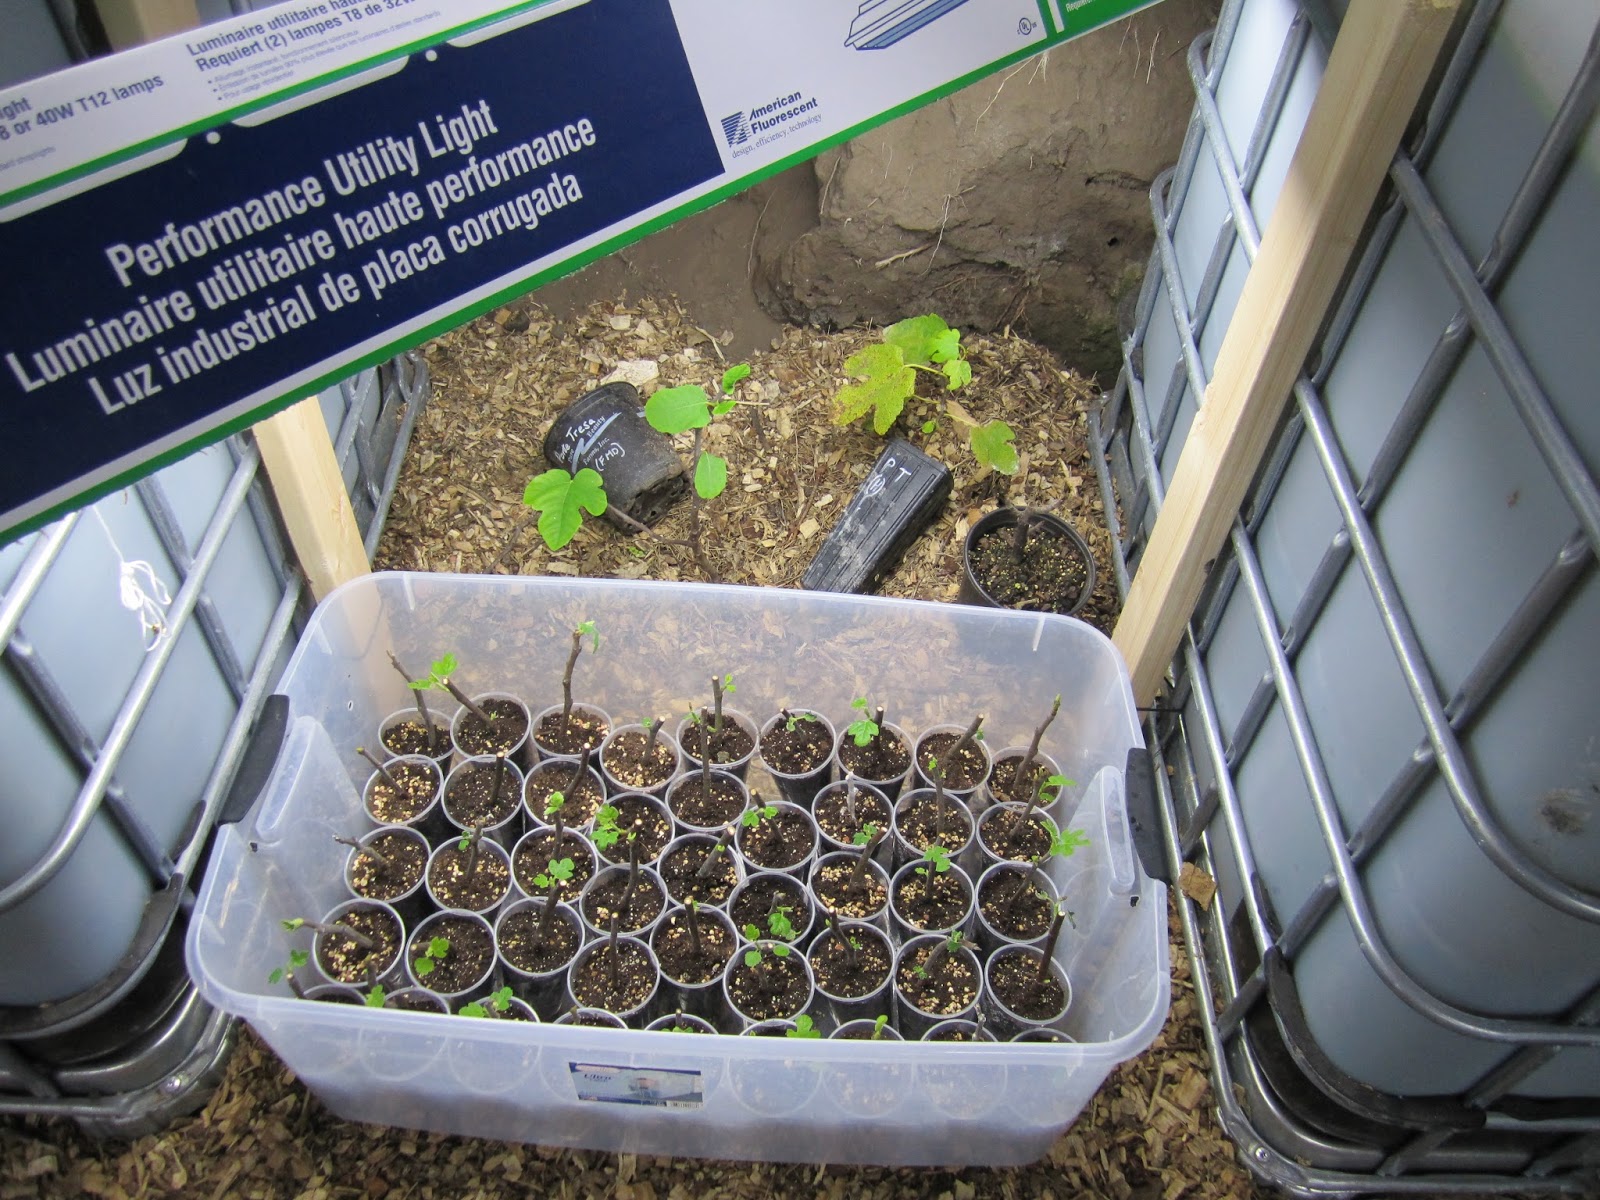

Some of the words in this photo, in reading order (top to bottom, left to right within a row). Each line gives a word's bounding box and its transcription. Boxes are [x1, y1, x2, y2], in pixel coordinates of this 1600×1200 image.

[185, 23, 266, 57] Luminaire
[267, 3, 328, 31] utilitaire
[195, 40, 264, 72] Requiert
[264, 32, 288, 52] (2)
[288, 16, 343, 41] lampes
[341, 8, 363, 22] T8
[364, 4, 383, 16] de
[14, 119, 32, 135] or
[36, 102, 75, 126] 40W
[76, 91, 111, 112] T12
[112, 75, 165, 101] lamps
[748, 91, 802, 122] American
[750, 97, 819, 135] Fluorescent
[789, 113, 823, 134] technology
[105, 175, 326, 288] Performance
[323, 135, 420, 196] Utility
[418, 99, 498, 159] Light
[5, 289, 196, 393] Luminaire
[197, 229, 336, 310] utilitaire
[333, 190, 424, 250] haute
[425, 117, 597, 220] performance
[88, 363, 163, 416] Luz
[156, 284, 317, 385] industrial
[318, 272, 361, 312] de
[361, 235, 447, 301] placa
[447, 172, 583, 254] corrugada
[565, 418, 596, 442] Tresa
[586, 415, 606, 438] Beauty
[894, 467, 912, 483] T
